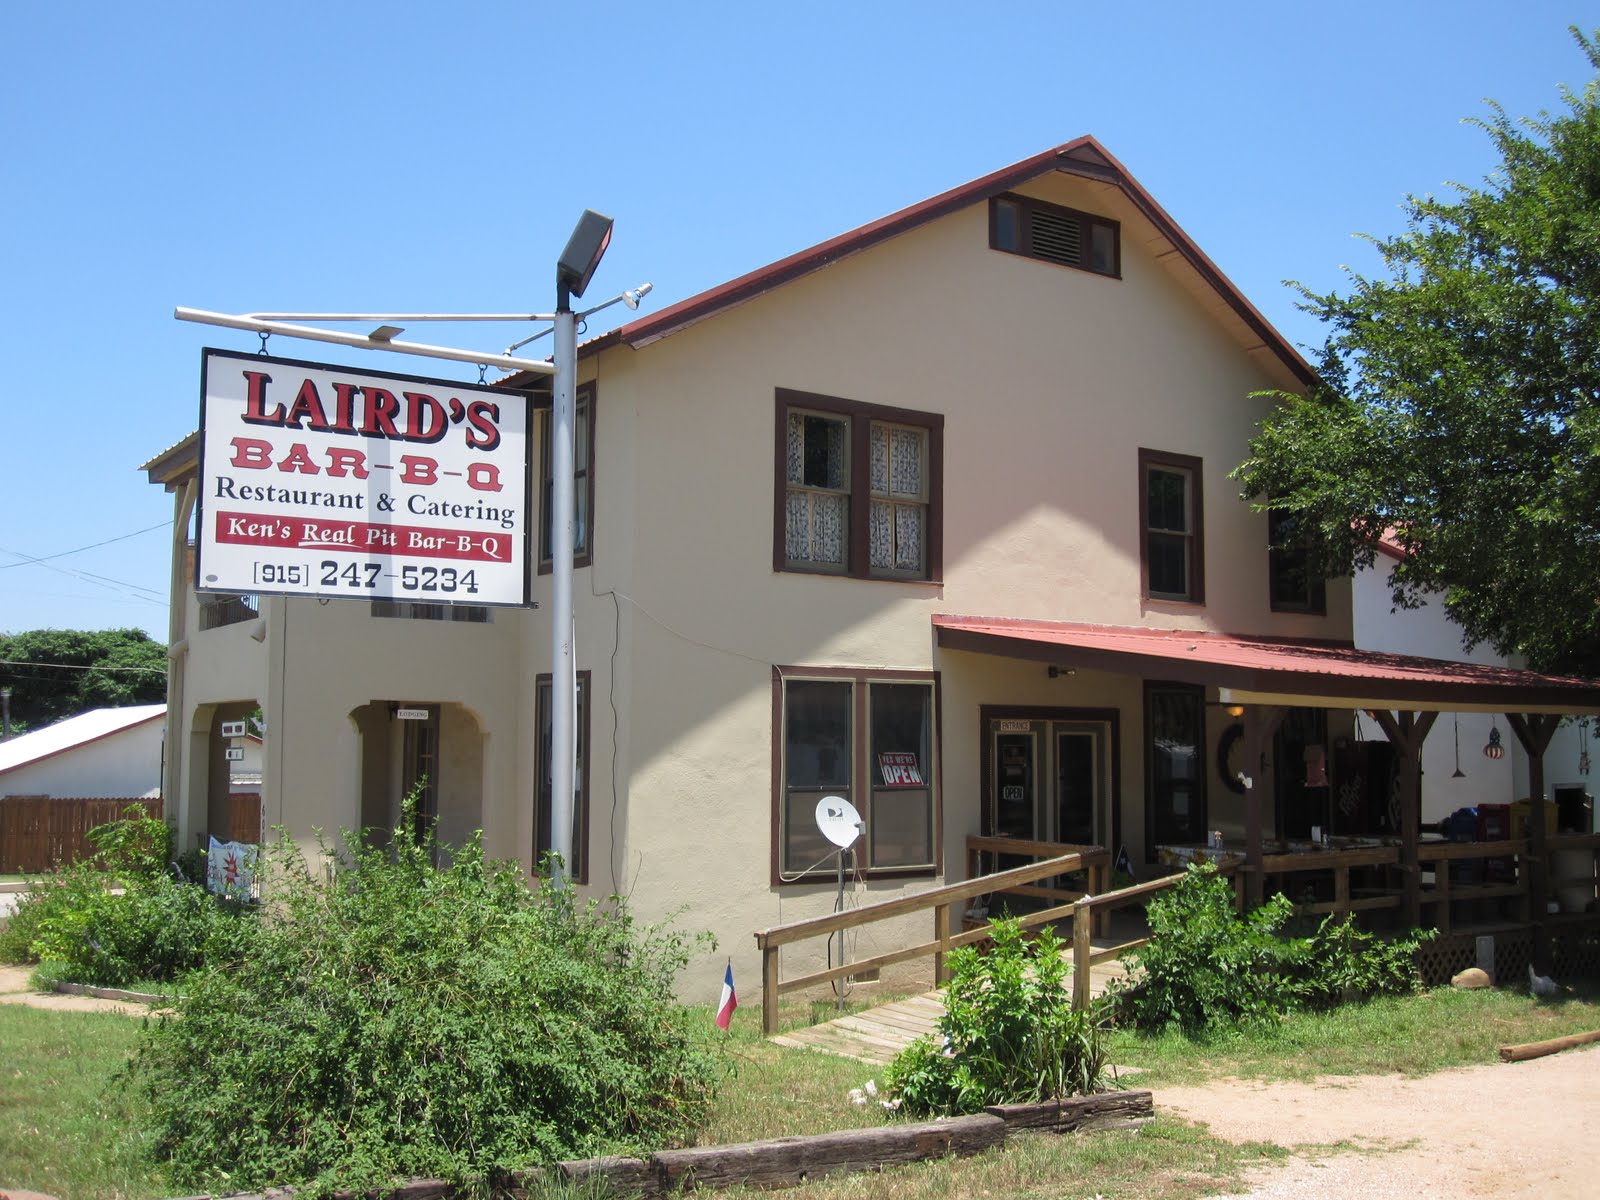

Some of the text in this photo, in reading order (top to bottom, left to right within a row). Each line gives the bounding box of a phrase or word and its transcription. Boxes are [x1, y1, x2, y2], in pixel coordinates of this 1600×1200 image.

[241, 371, 500, 451] LAIRD'S
[230, 437, 503, 492] BAR-B-Q
[215, 476, 515, 529] Restaurant & Catering
[227, 518, 502, 559] Ken's Real Pit Bar-B-Q
[254, 560, 479, 593] [915] 247-5234
[1002, 721, 1029, 730] ENTRANCE
[883, 766, 920, 783] OPEN
[1004, 786, 1023, 799] OPEN
